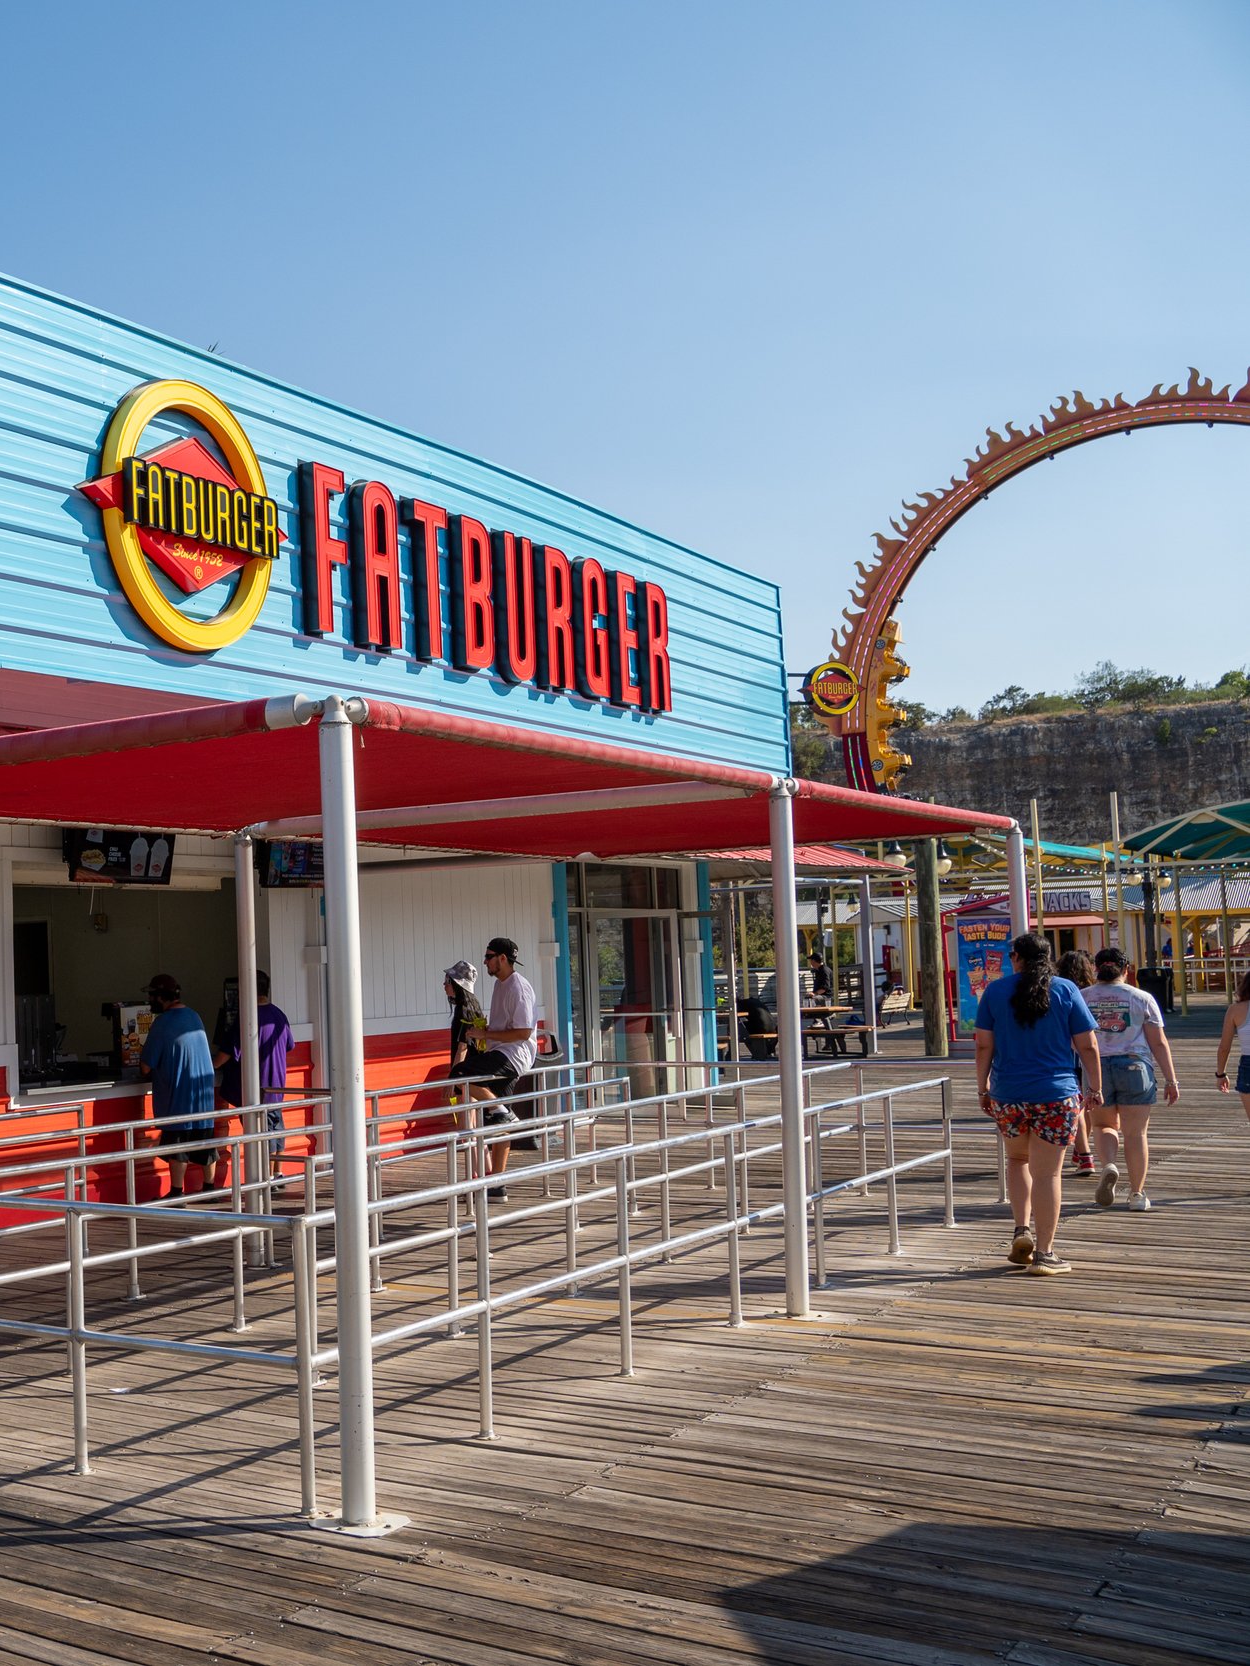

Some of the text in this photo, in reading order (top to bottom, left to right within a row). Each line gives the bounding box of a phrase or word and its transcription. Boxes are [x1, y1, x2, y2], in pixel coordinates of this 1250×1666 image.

[130, 458, 279, 559] FATBURGER
[172, 543, 225, 568] Since 1952
[302, 460, 673, 716] FATBURGER
[813, 682, 859, 696] FATBURGER
[958, 923, 1011, 935] FASTEN YOUR
[963, 931, 1007, 942] TASTE BUDS
